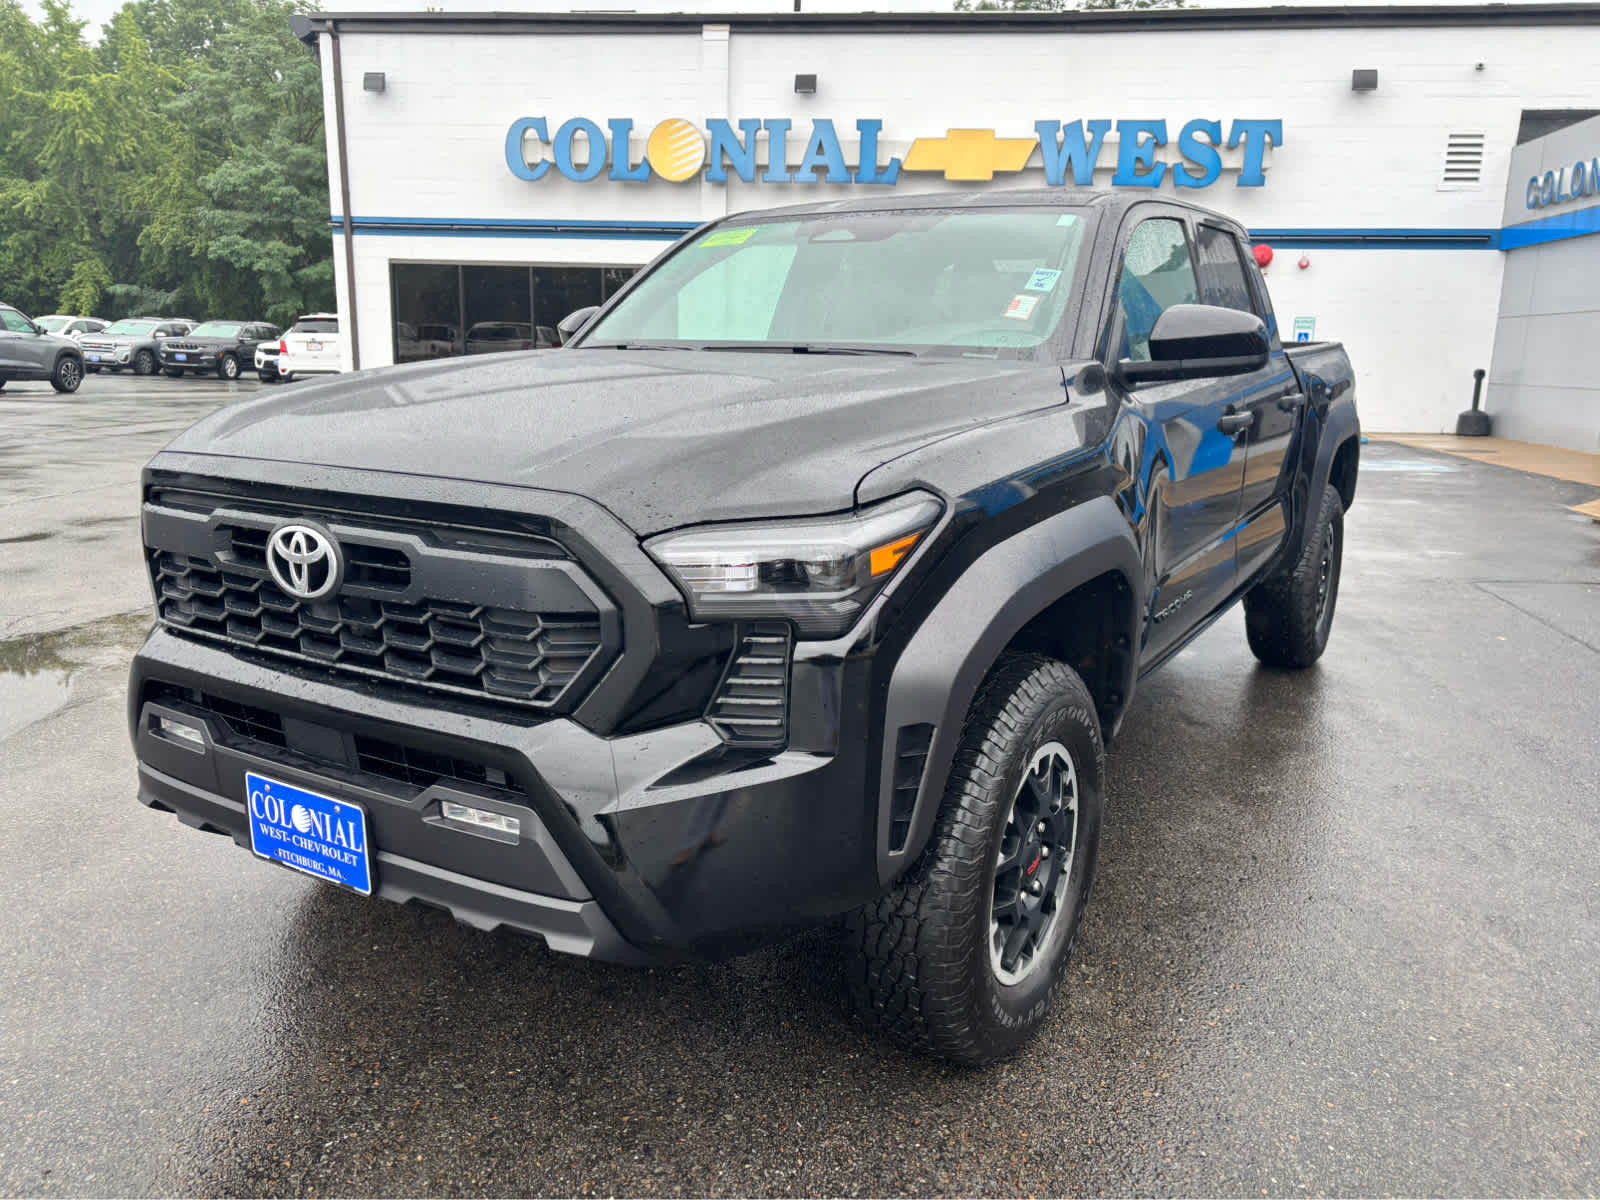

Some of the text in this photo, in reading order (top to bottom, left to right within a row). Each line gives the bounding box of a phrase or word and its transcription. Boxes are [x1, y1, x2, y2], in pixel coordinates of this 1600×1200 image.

[505, 116, 1283, 188] COLONIAL WEST
[251, 790, 362, 853] COLONIAL
